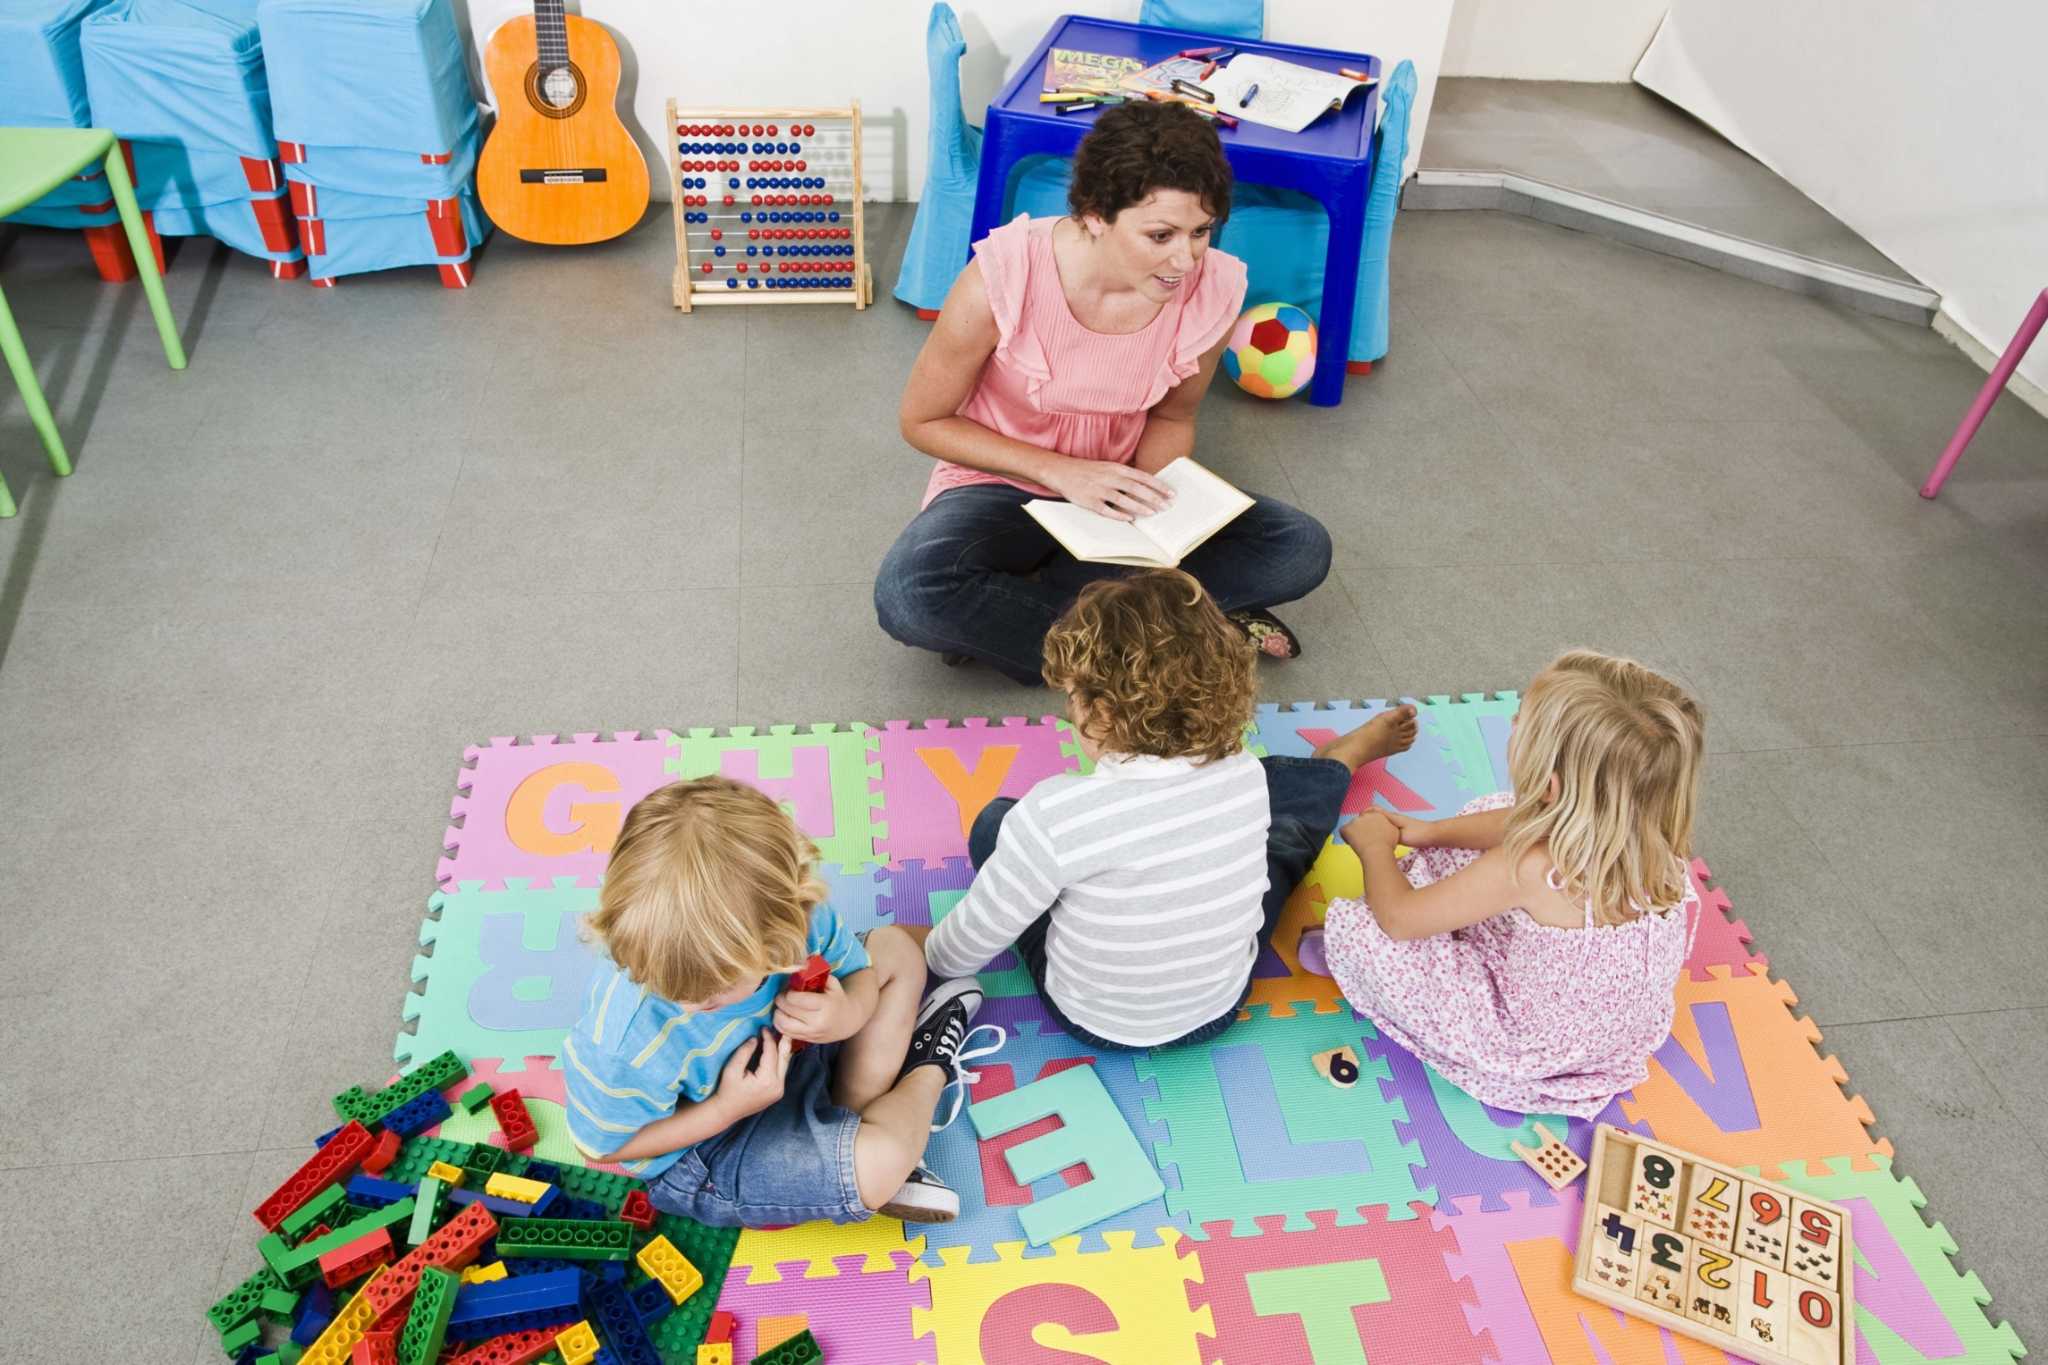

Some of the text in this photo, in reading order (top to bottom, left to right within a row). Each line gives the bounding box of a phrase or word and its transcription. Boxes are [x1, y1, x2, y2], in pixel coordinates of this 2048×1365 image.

[1055, 49, 1142, 72] MEGA
[505, 762, 619, 856] G
[914, 744, 1021, 839] Y
[1211, 1044, 1374, 1183] L
[1642, 1154, 1675, 1189] 8
[1697, 1177, 1730, 1212] 7
[1800, 1209, 1833, 1247] 5
[1697, 1247, 1733, 1290] 2
[1245, 1258, 1392, 1365] T
